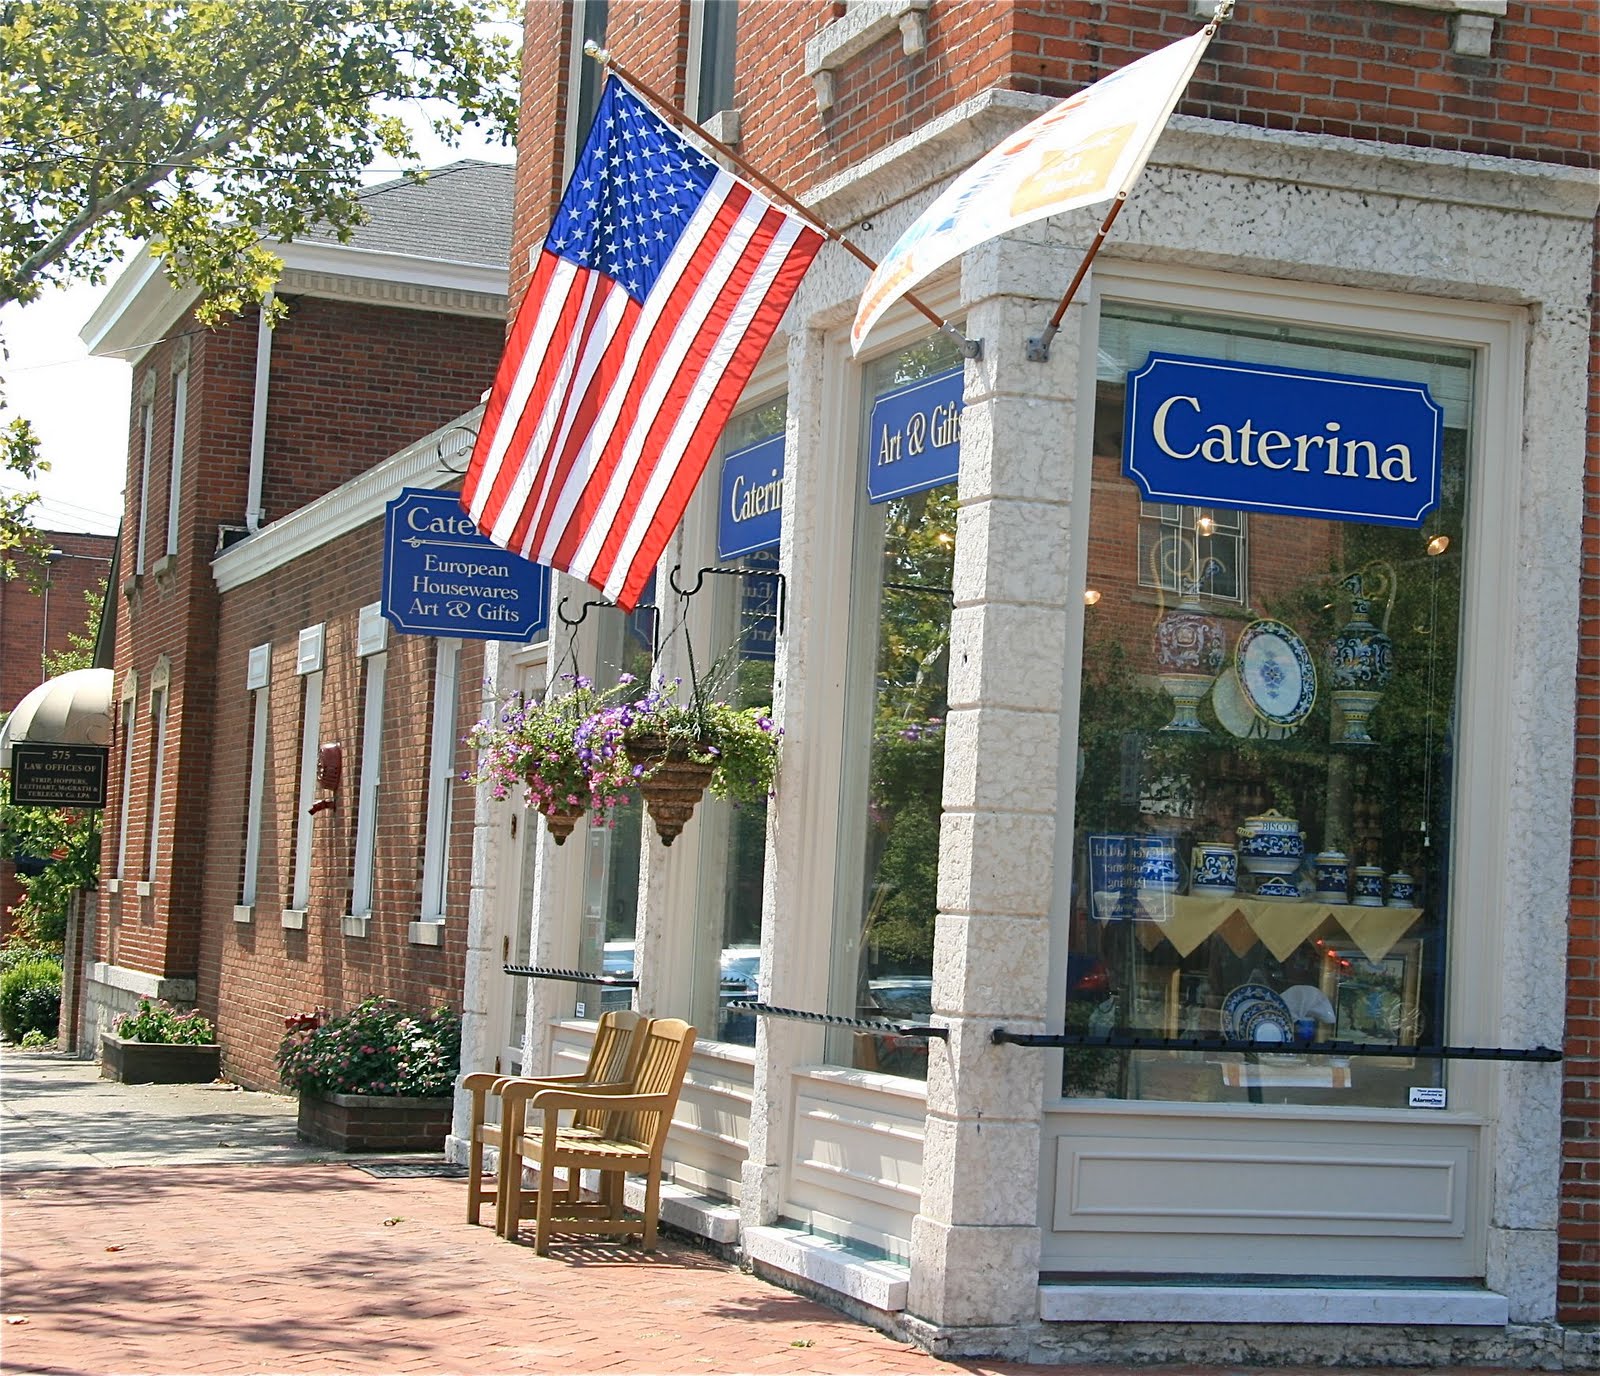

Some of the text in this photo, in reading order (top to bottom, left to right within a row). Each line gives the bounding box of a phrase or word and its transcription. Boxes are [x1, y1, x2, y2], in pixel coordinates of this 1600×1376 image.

[877, 423, 903, 467] Art
[906, 411, 926, 456] &
[1152, 395, 1418, 483] Caterina
[731, 468, 784, 523] Caterin
[407, 506, 482, 537] Cater
[424, 554, 510, 578] European
[412, 575, 519, 600] Housewares
[409, 598, 520, 622] Art & Gifts
[51, 750, 71, 760] 575
[24, 762, 97, 773] LAW OFFICES OF
[77, 791, 90, 799] LPA
